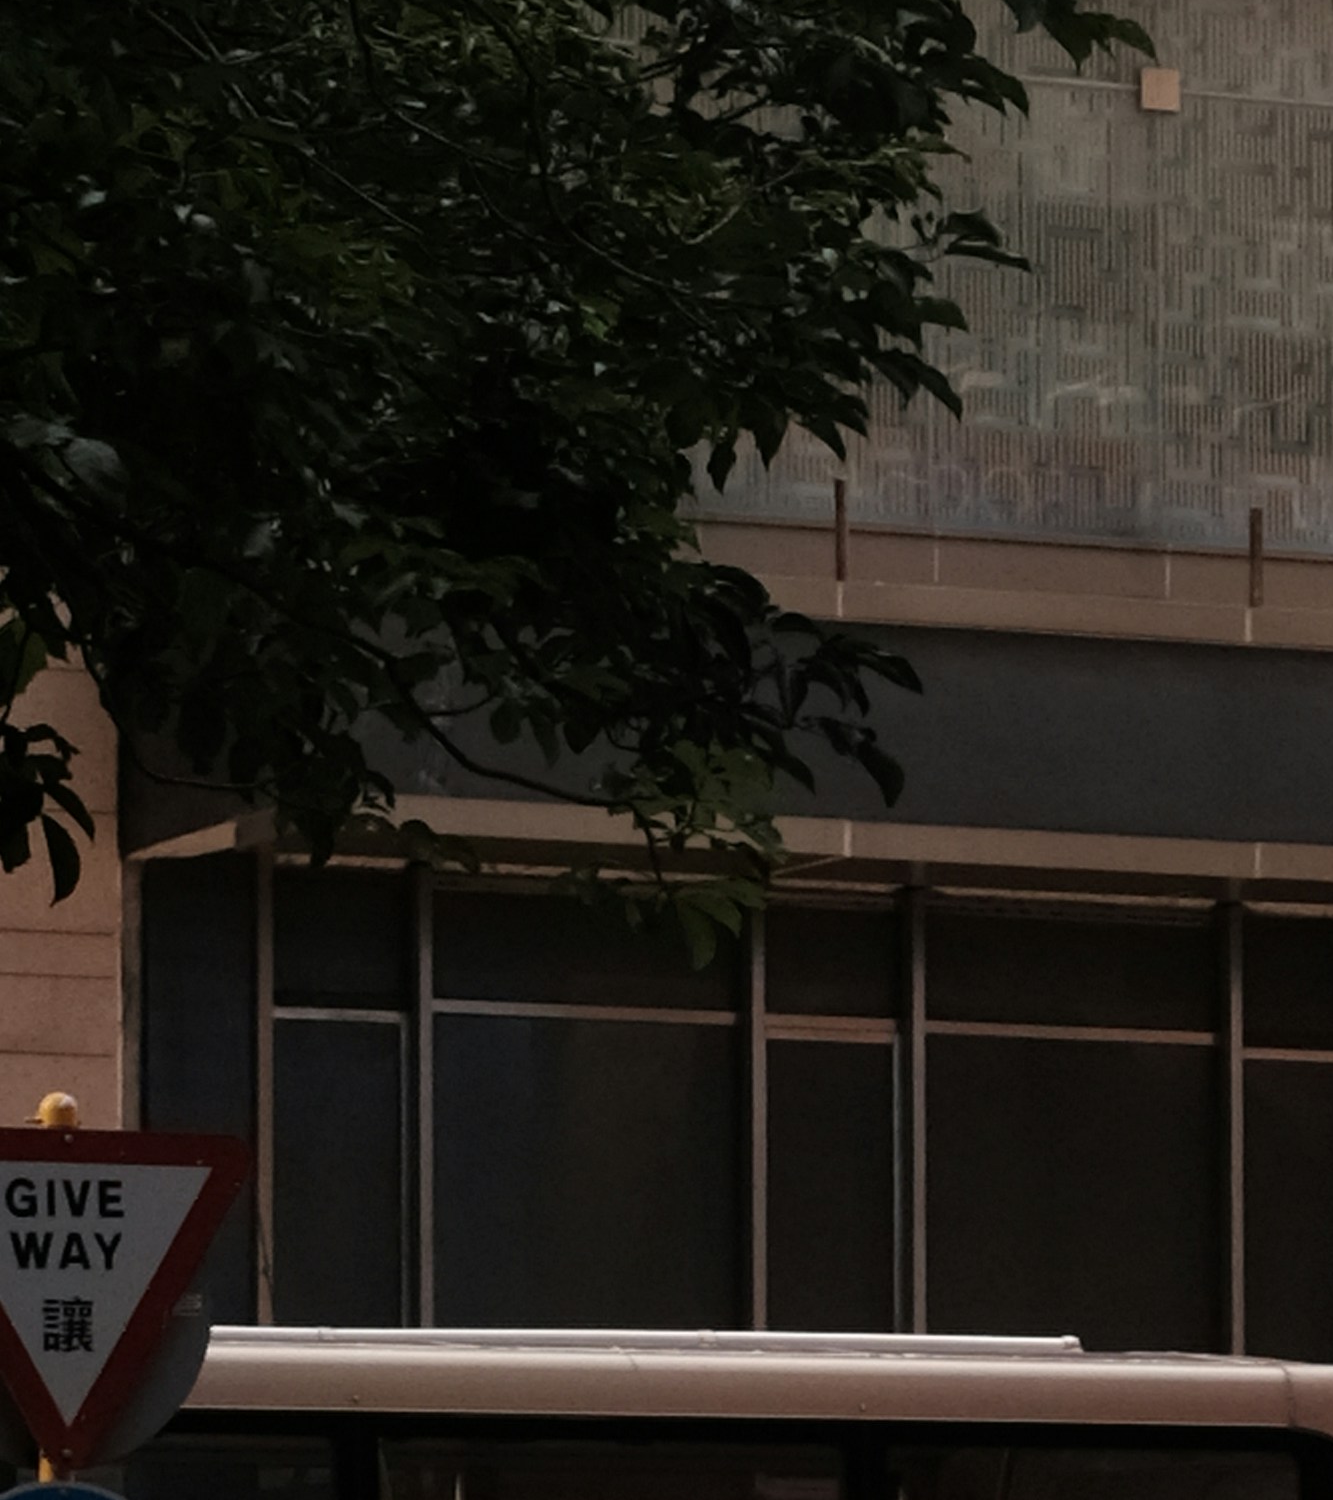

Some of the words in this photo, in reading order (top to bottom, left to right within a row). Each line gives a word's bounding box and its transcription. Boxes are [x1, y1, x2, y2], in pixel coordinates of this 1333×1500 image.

[5, 1177, 125, 1218] GIVE
[10, 1232, 122, 1270] WAY
[42, 1297, 94, 1352] 讓
